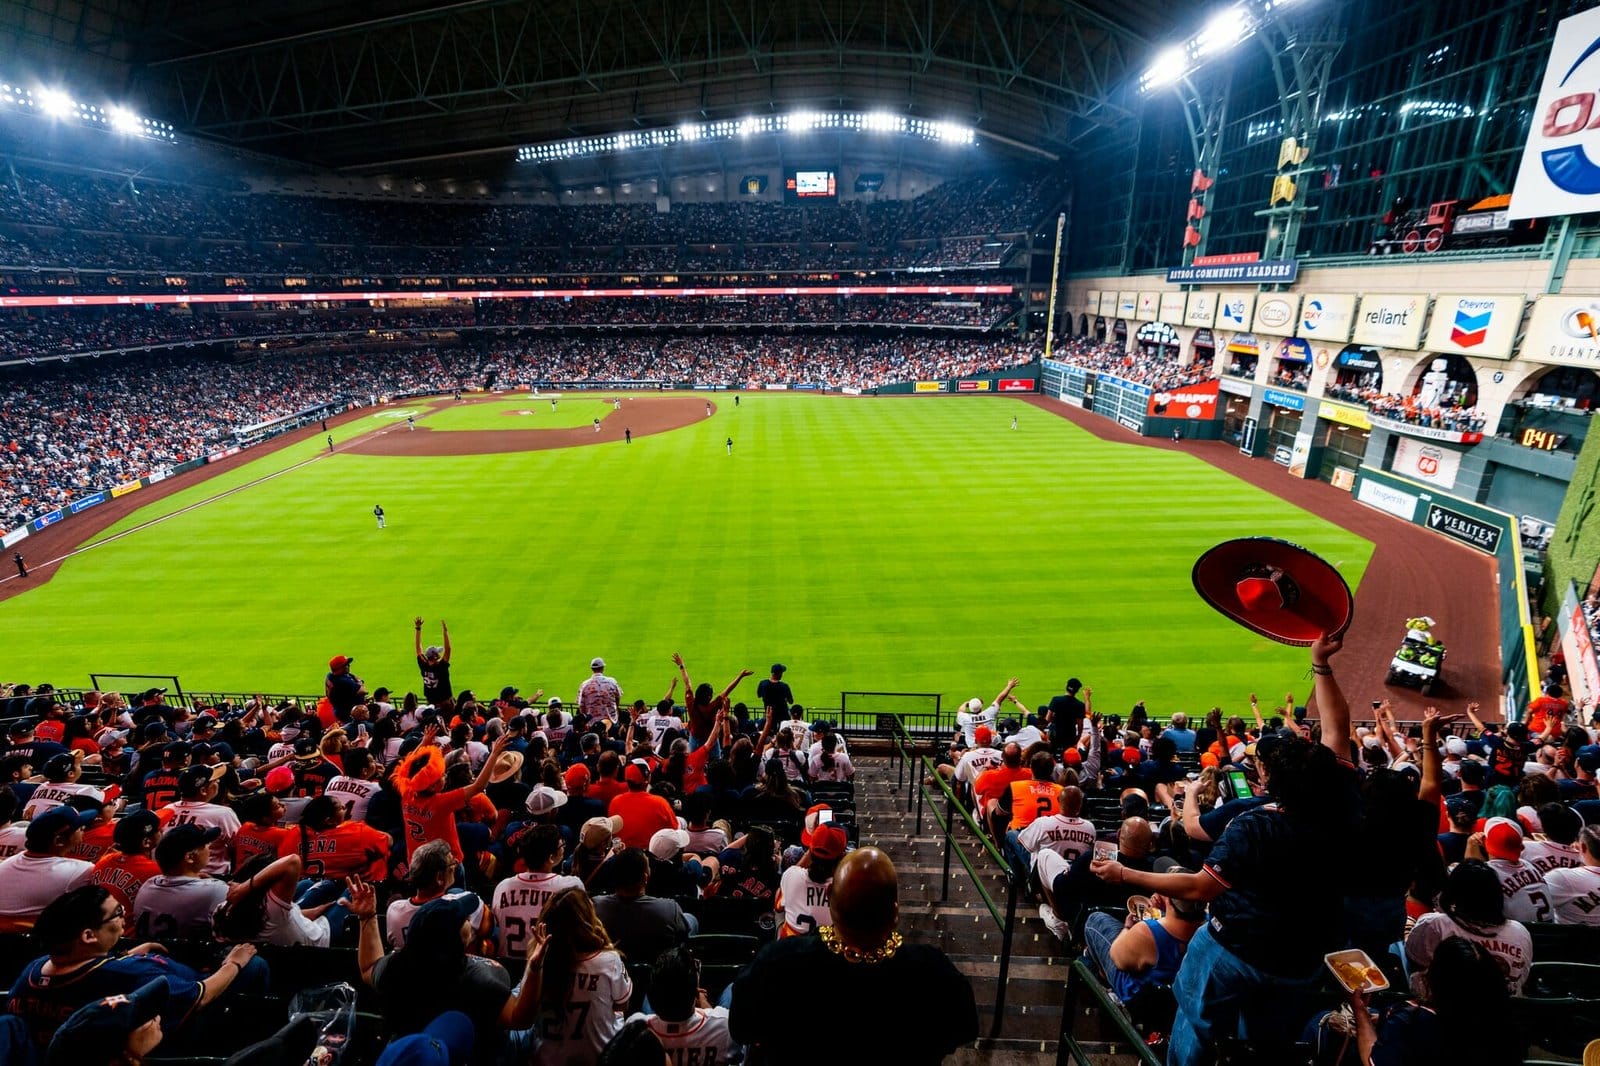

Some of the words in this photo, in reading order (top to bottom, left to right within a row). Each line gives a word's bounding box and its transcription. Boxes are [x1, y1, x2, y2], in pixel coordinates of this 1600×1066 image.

[1542, 92, 1600, 138] O
[1169, 269, 1194, 280] ASTROS
[1195, 266, 1245, 279] COMMUNITY
[1246, 264, 1291, 278] LEADERS
[1458, 299, 1495, 309] Chevron
[1304, 311, 1322, 320] OXY
[1364, 307, 1408, 326] reliant
[1419, 458, 1437, 473] 66
[1443, 514, 1496, 543] VERITEX
[655, 728, 665, 742] 7
[326, 782, 371, 798] ALVAREZ
[144, 790, 178, 810] 15
[168, 810, 197, 828] EÑA
[407, 818, 426, 842] 2
[1047, 825, 1095, 845] VÁZQUEZ
[1529, 891, 1553, 923] 2
